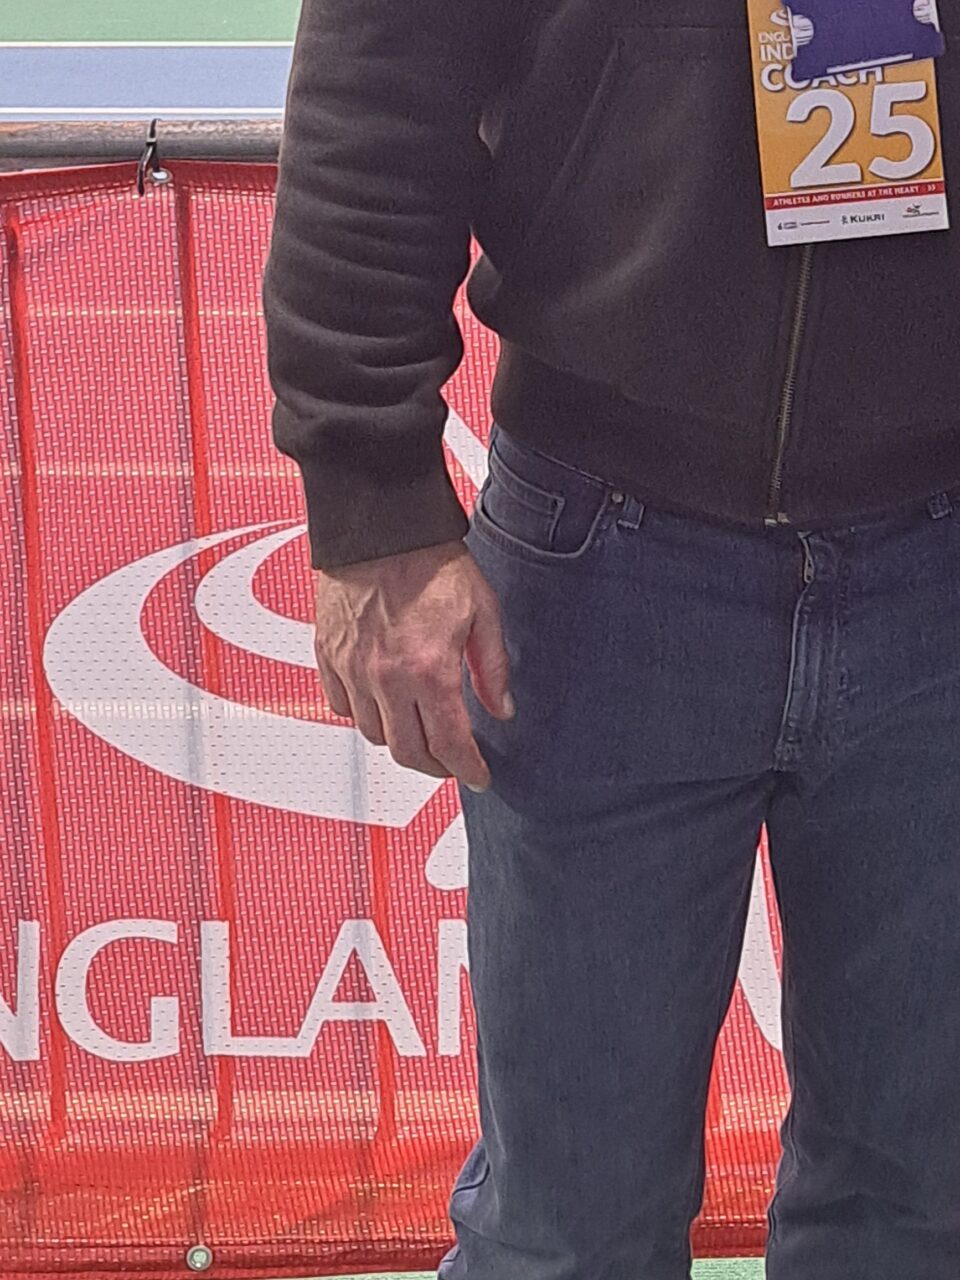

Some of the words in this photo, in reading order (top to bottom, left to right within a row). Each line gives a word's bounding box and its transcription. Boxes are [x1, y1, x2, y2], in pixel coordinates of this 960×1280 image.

[786, 80, 936, 188] 25
[867, 189, 877, 197] AT
[879, 188, 893, 196] THE
[850, 214, 885, 223] KUKRI
